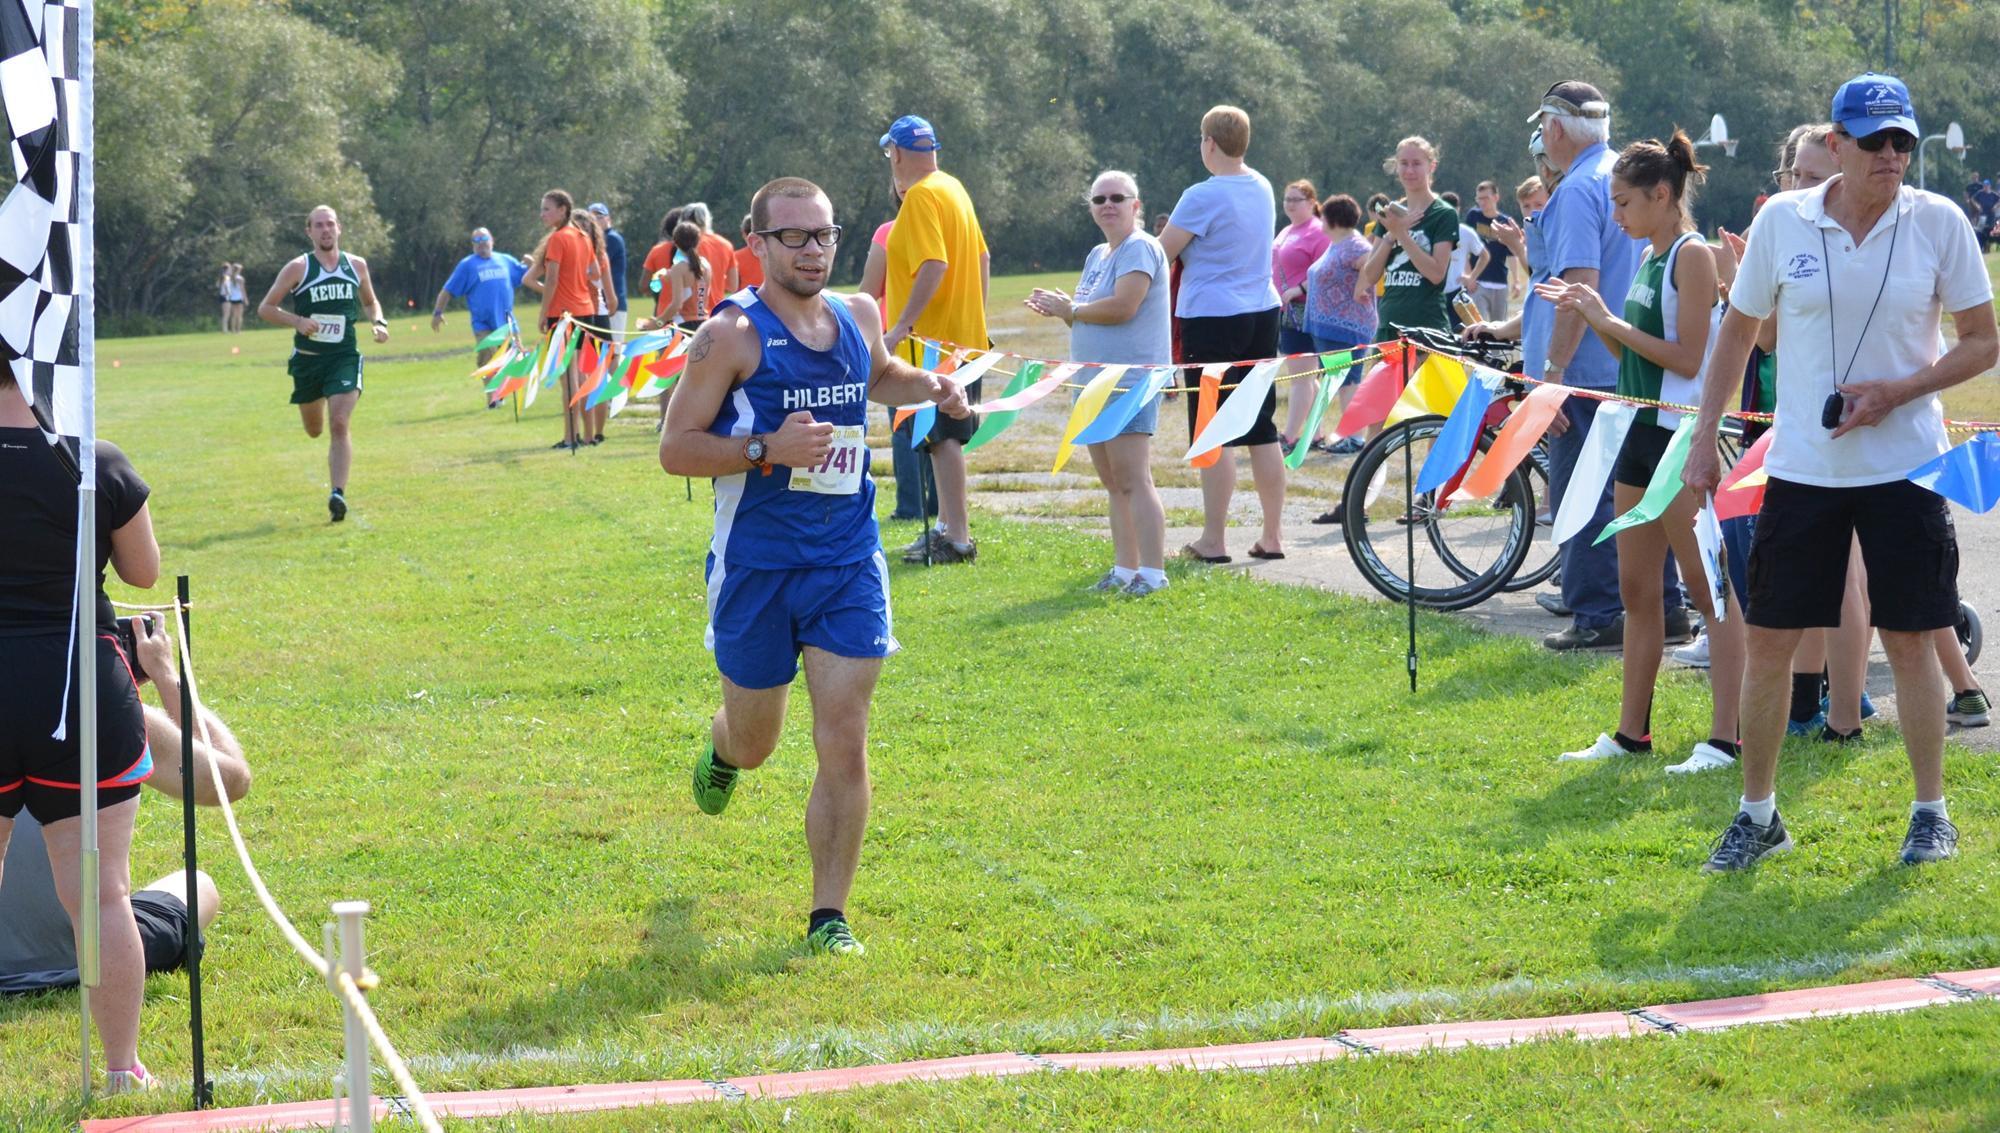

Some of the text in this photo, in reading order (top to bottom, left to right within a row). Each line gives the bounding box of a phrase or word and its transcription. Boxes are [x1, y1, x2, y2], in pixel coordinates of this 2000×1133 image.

[309, 283, 354, 303] KEUKA
[783, 382, 866, 409] HILBERT
[808, 446, 857, 474] 741
